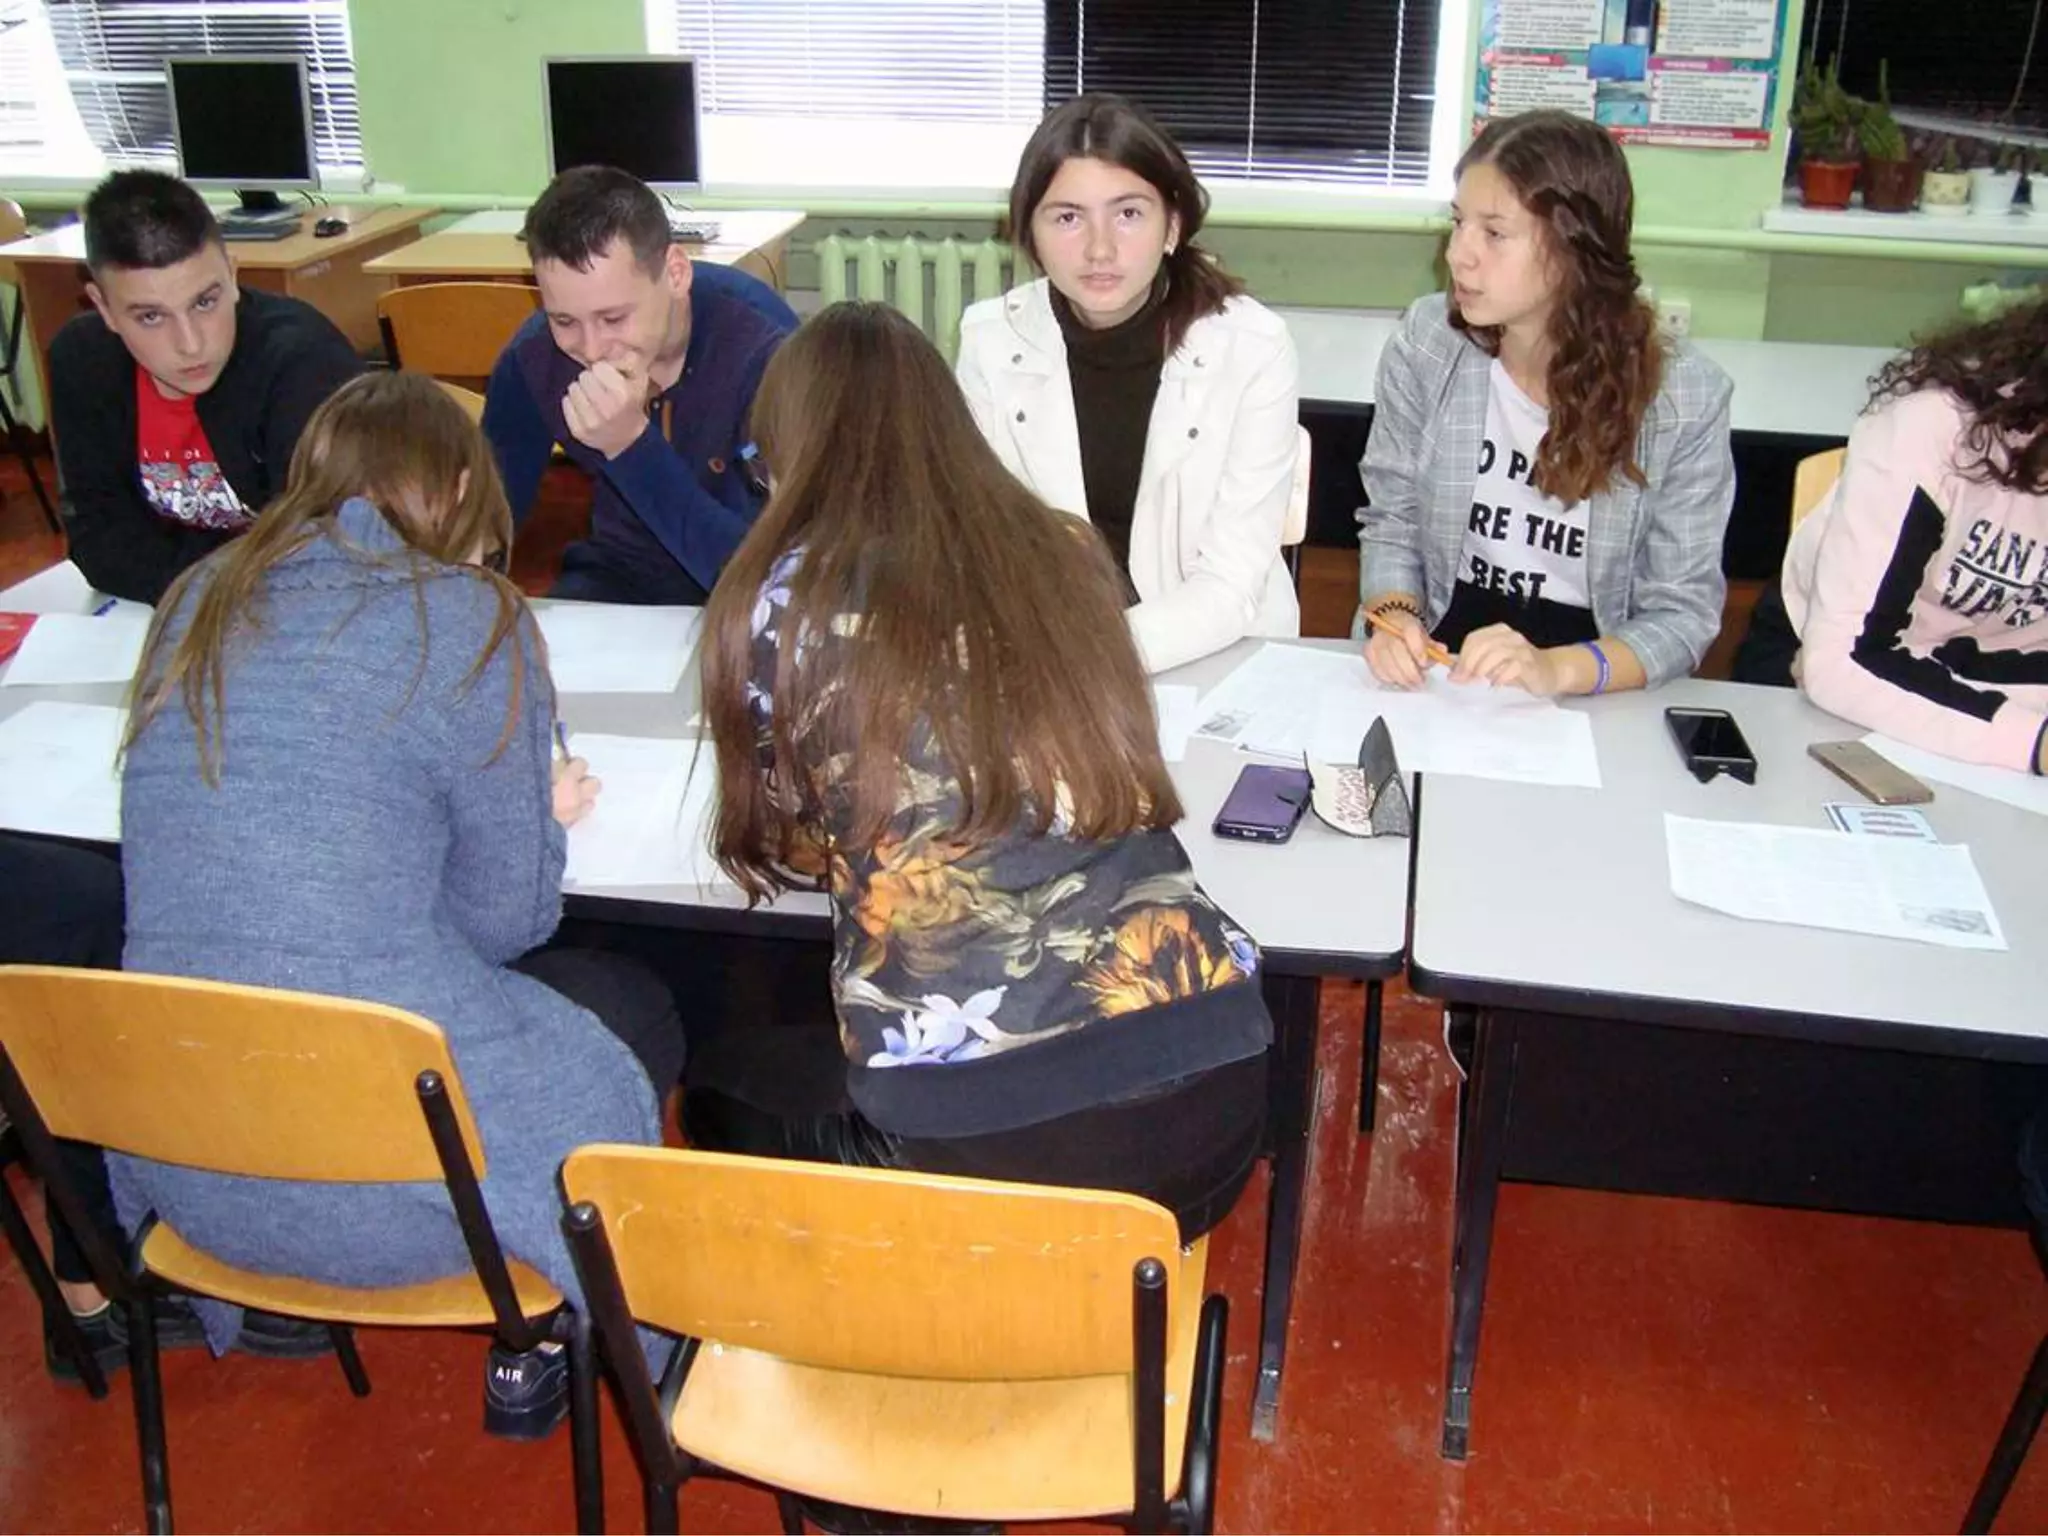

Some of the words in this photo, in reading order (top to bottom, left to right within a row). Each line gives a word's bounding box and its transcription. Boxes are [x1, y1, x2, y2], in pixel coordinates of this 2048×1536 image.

[1478, 439, 1496, 474] O
[1468, 502, 1511, 540] RE
[1526, 513, 1585, 558] THE
[1959, 519, 2037, 580] SAN
[1470, 555, 1547, 599] BEST
[496, 1366, 523, 1383] AIR
